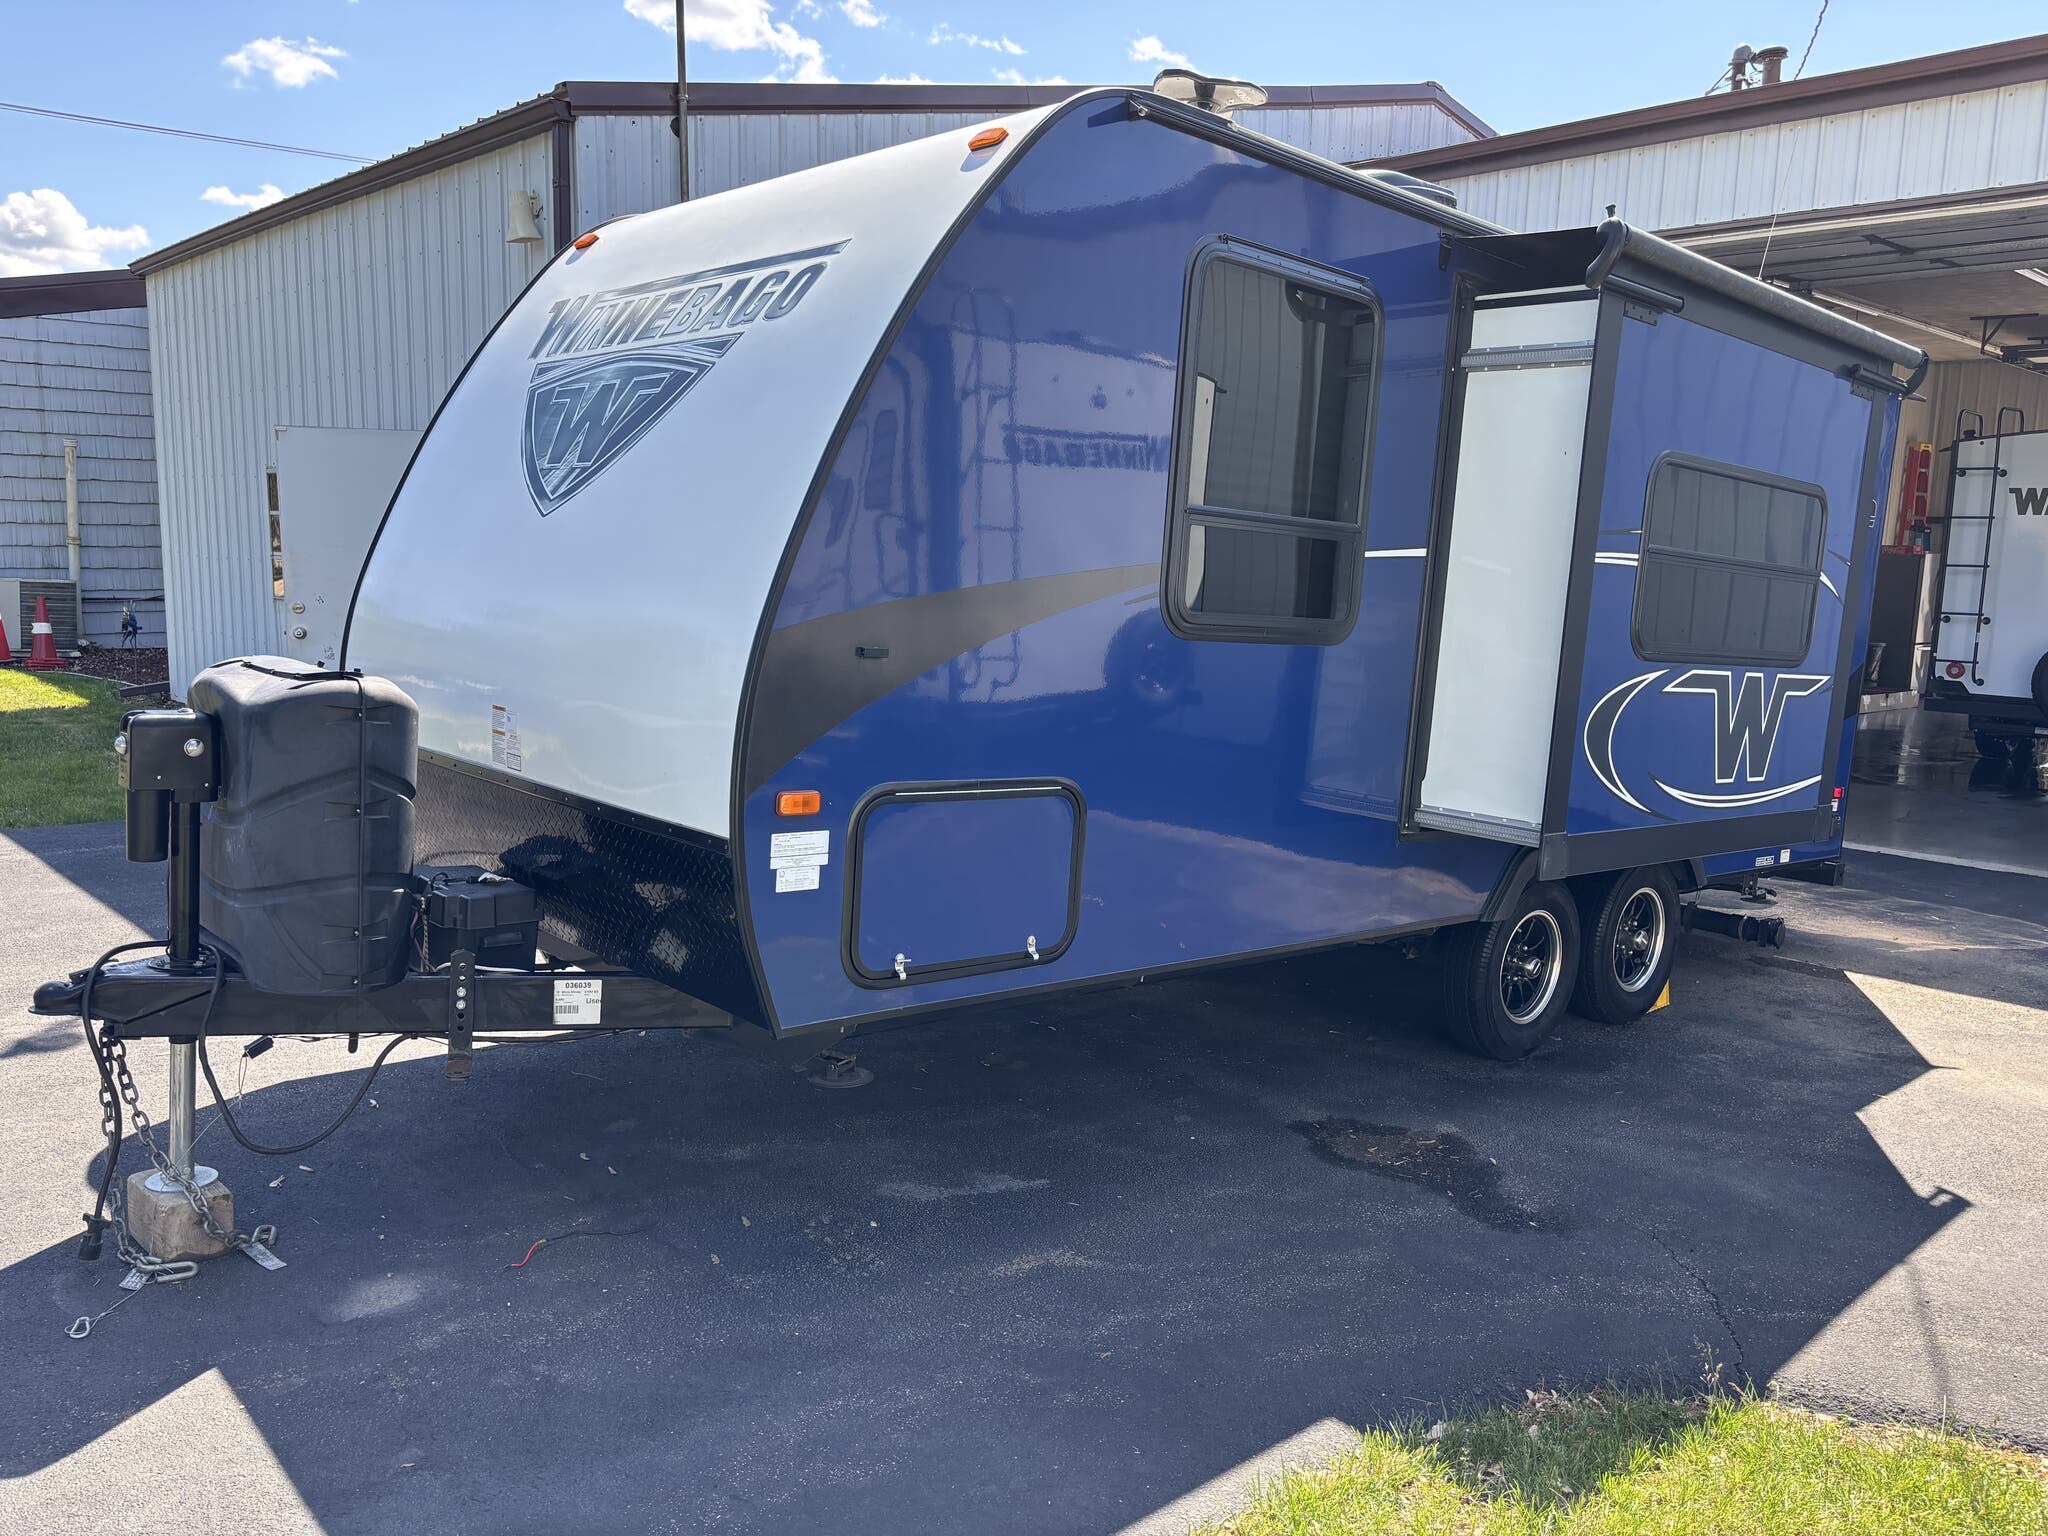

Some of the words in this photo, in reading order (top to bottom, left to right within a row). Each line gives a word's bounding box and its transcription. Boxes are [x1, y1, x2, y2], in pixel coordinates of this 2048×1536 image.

[527, 261, 828, 360] WINNEBAGO
[547, 371, 676, 468] W
[1662, 669, 1832, 783] W
[585, 997, 601, 1005] Use
